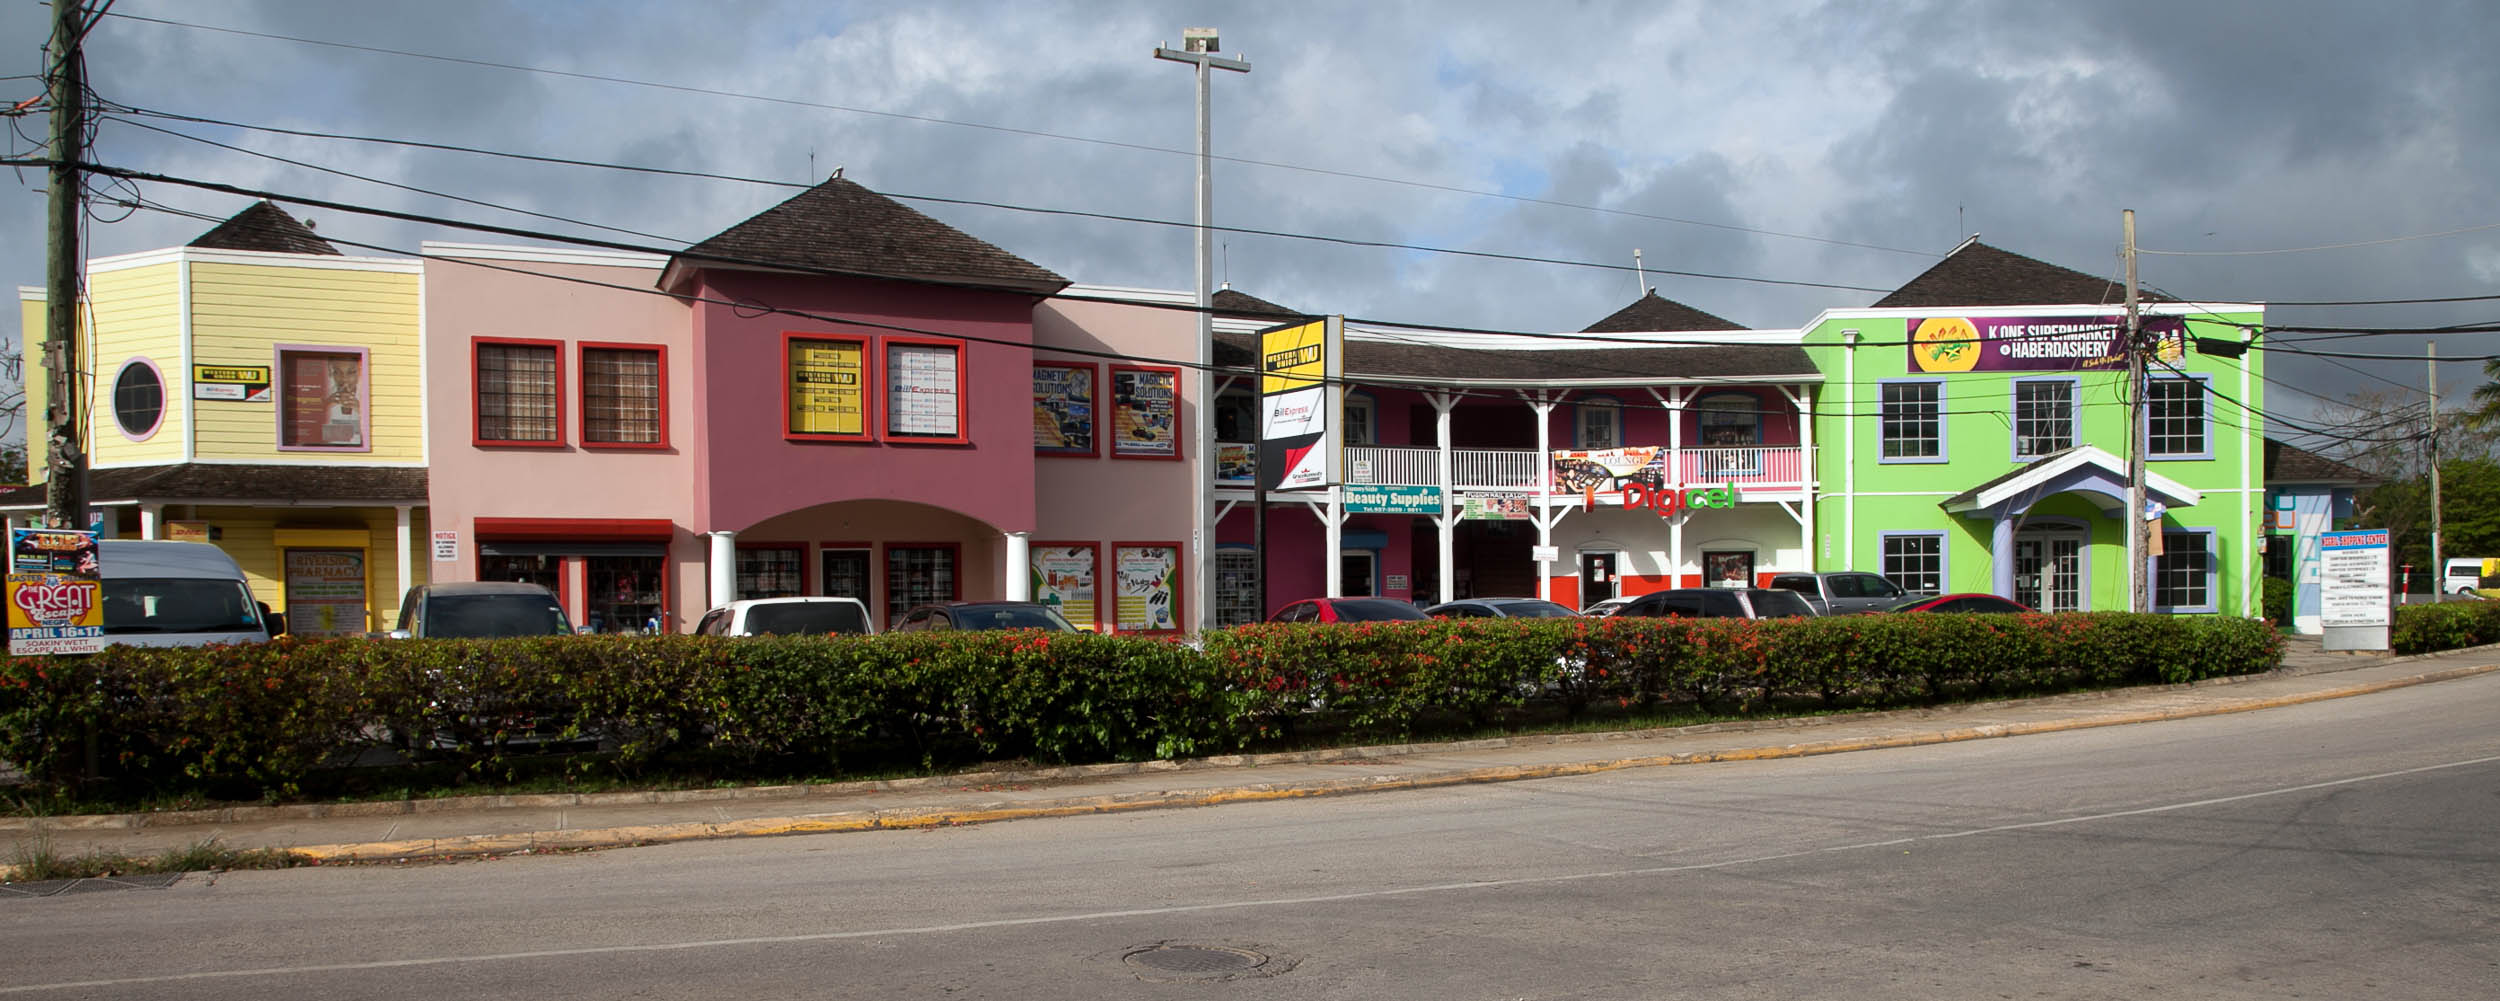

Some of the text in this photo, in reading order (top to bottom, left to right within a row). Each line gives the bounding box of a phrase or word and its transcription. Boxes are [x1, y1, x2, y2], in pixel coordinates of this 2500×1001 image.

[1988, 325, 1998, 339] K
[2011, 341, 2110, 358] HABERDASHERY
[1267, 351, 1298, 363] WESTERN
[1276, 357, 1298, 369] UNION
[1139, 373, 1173, 386] MAGNETIC
[1135, 386, 1173, 399] SOLUTIONS
[1346, 490, 1440, 507] Beauty Supplies
[1623, 481, 1735, 517] Digicel
[15, 584, 96, 613] GREAT
[12, 628, 57, 639] APRIL
[71, 645, 99, 653] WHITE
